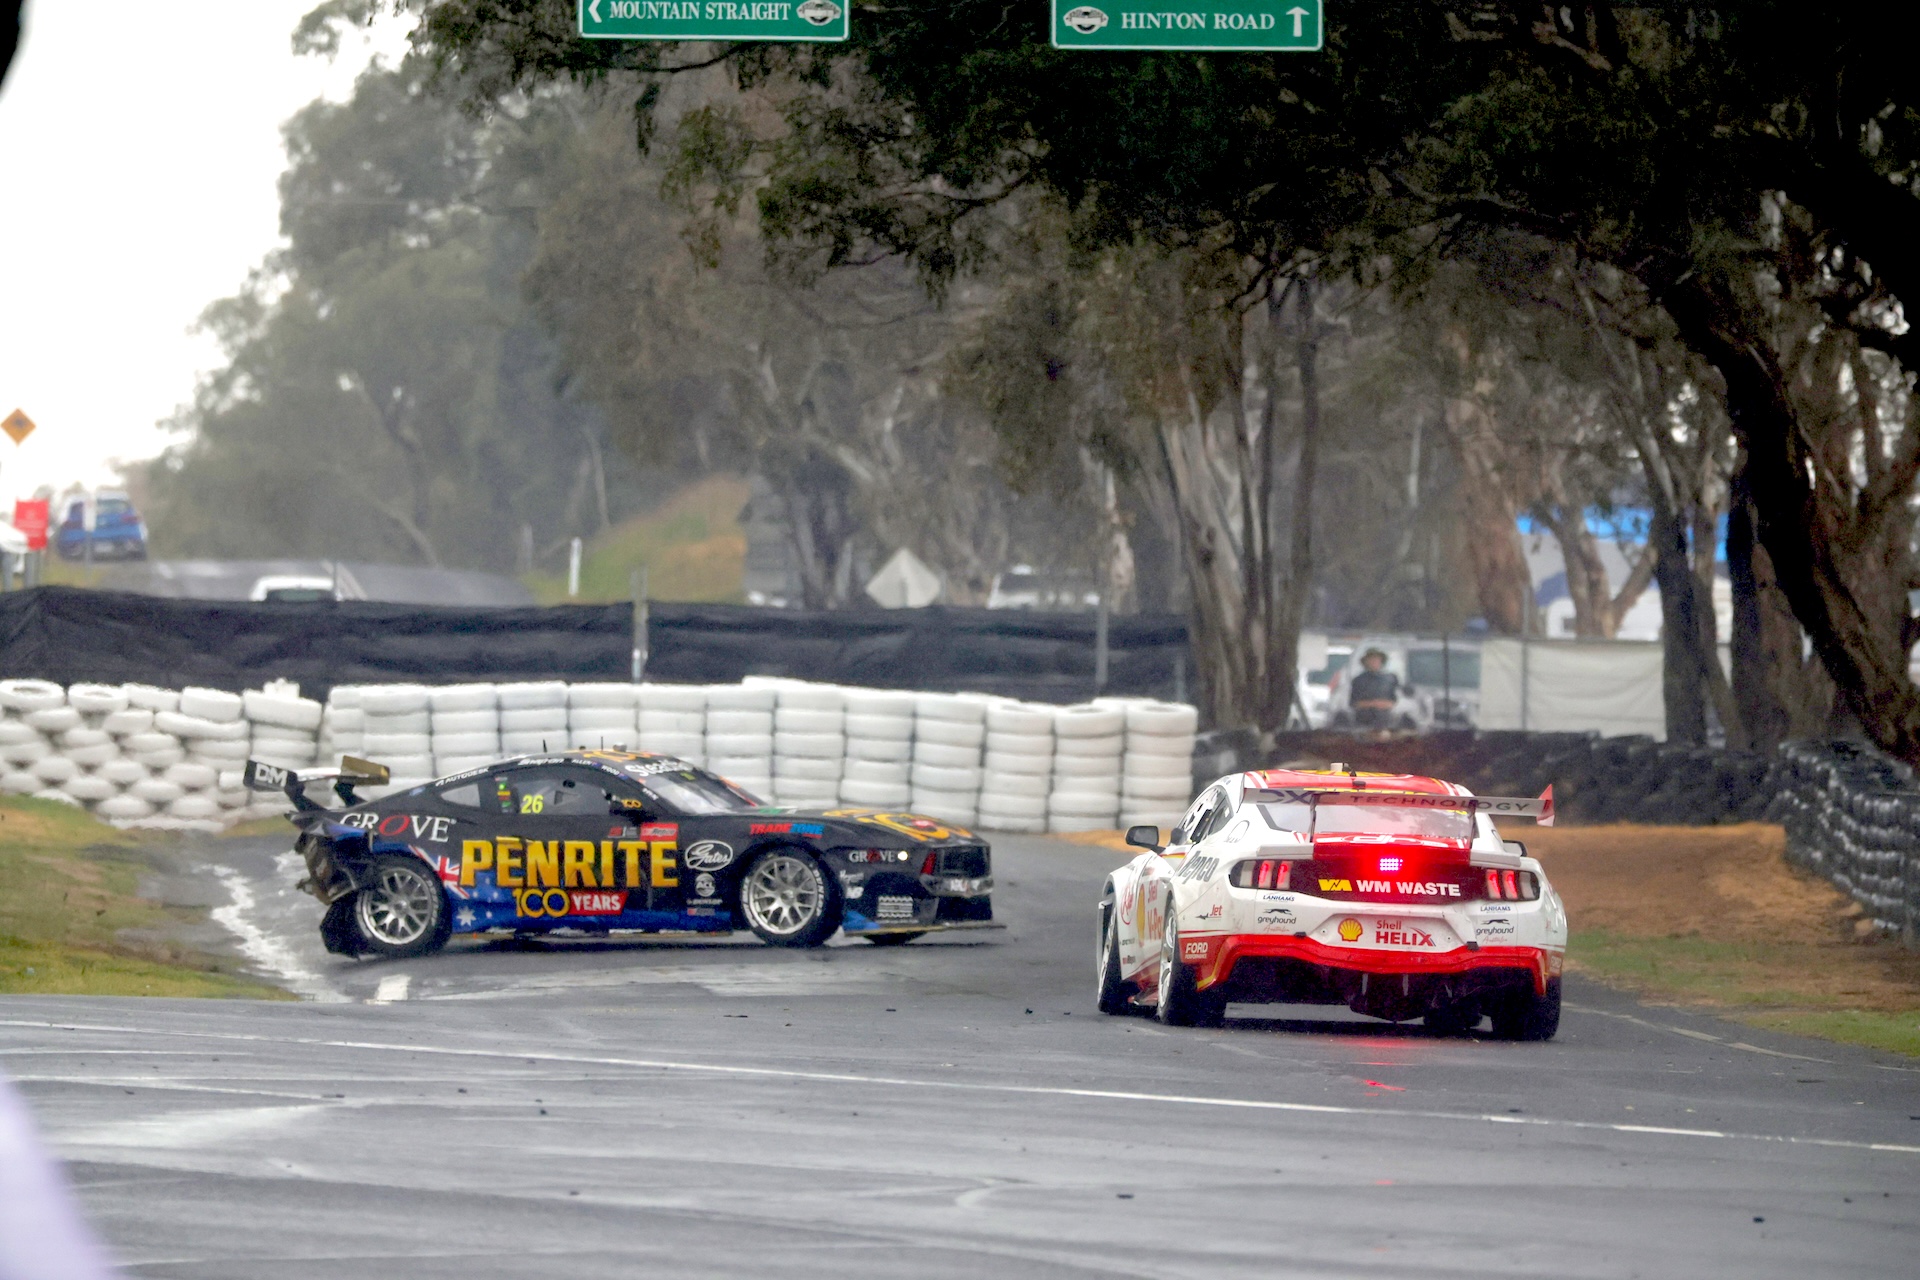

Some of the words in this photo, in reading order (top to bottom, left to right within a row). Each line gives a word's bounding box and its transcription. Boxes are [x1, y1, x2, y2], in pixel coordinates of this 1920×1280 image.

[609, 1, 700, 19] MOUNTAIN
[705, 2, 791, 20] STRAIGHT
[1121, 12, 1206, 29] HINTON
[1213, 13, 1275, 30] ROAD
[255, 763, 289, 788] DM
[445, 766, 490, 783] AUTODESK
[521, 794, 544, 814] 26
[1350, 795, 1531, 811] TECHNOLOGY
[339, 813, 450, 842] GROVE
[460, 838, 679, 887] PENRITE
[689, 844, 730, 867] Gates
[849, 848, 896, 864] GROVE
[1179, 851, 1219, 884] Repco
[1356, 879, 1391, 893] WM
[1396, 881, 1461, 897] WASTE
[512, 888, 571, 918] 100
[571, 892, 622, 912] YEARS
[1209, 904, 1223, 917] Jet
[1257, 916, 1297, 925] greyhound
[1376, 919, 1402, 930] Shell
[1376, 929, 1435, 947] HELIX
[1476, 926, 1515, 936] greyhound
[1185, 942, 1209, 953] FORD
